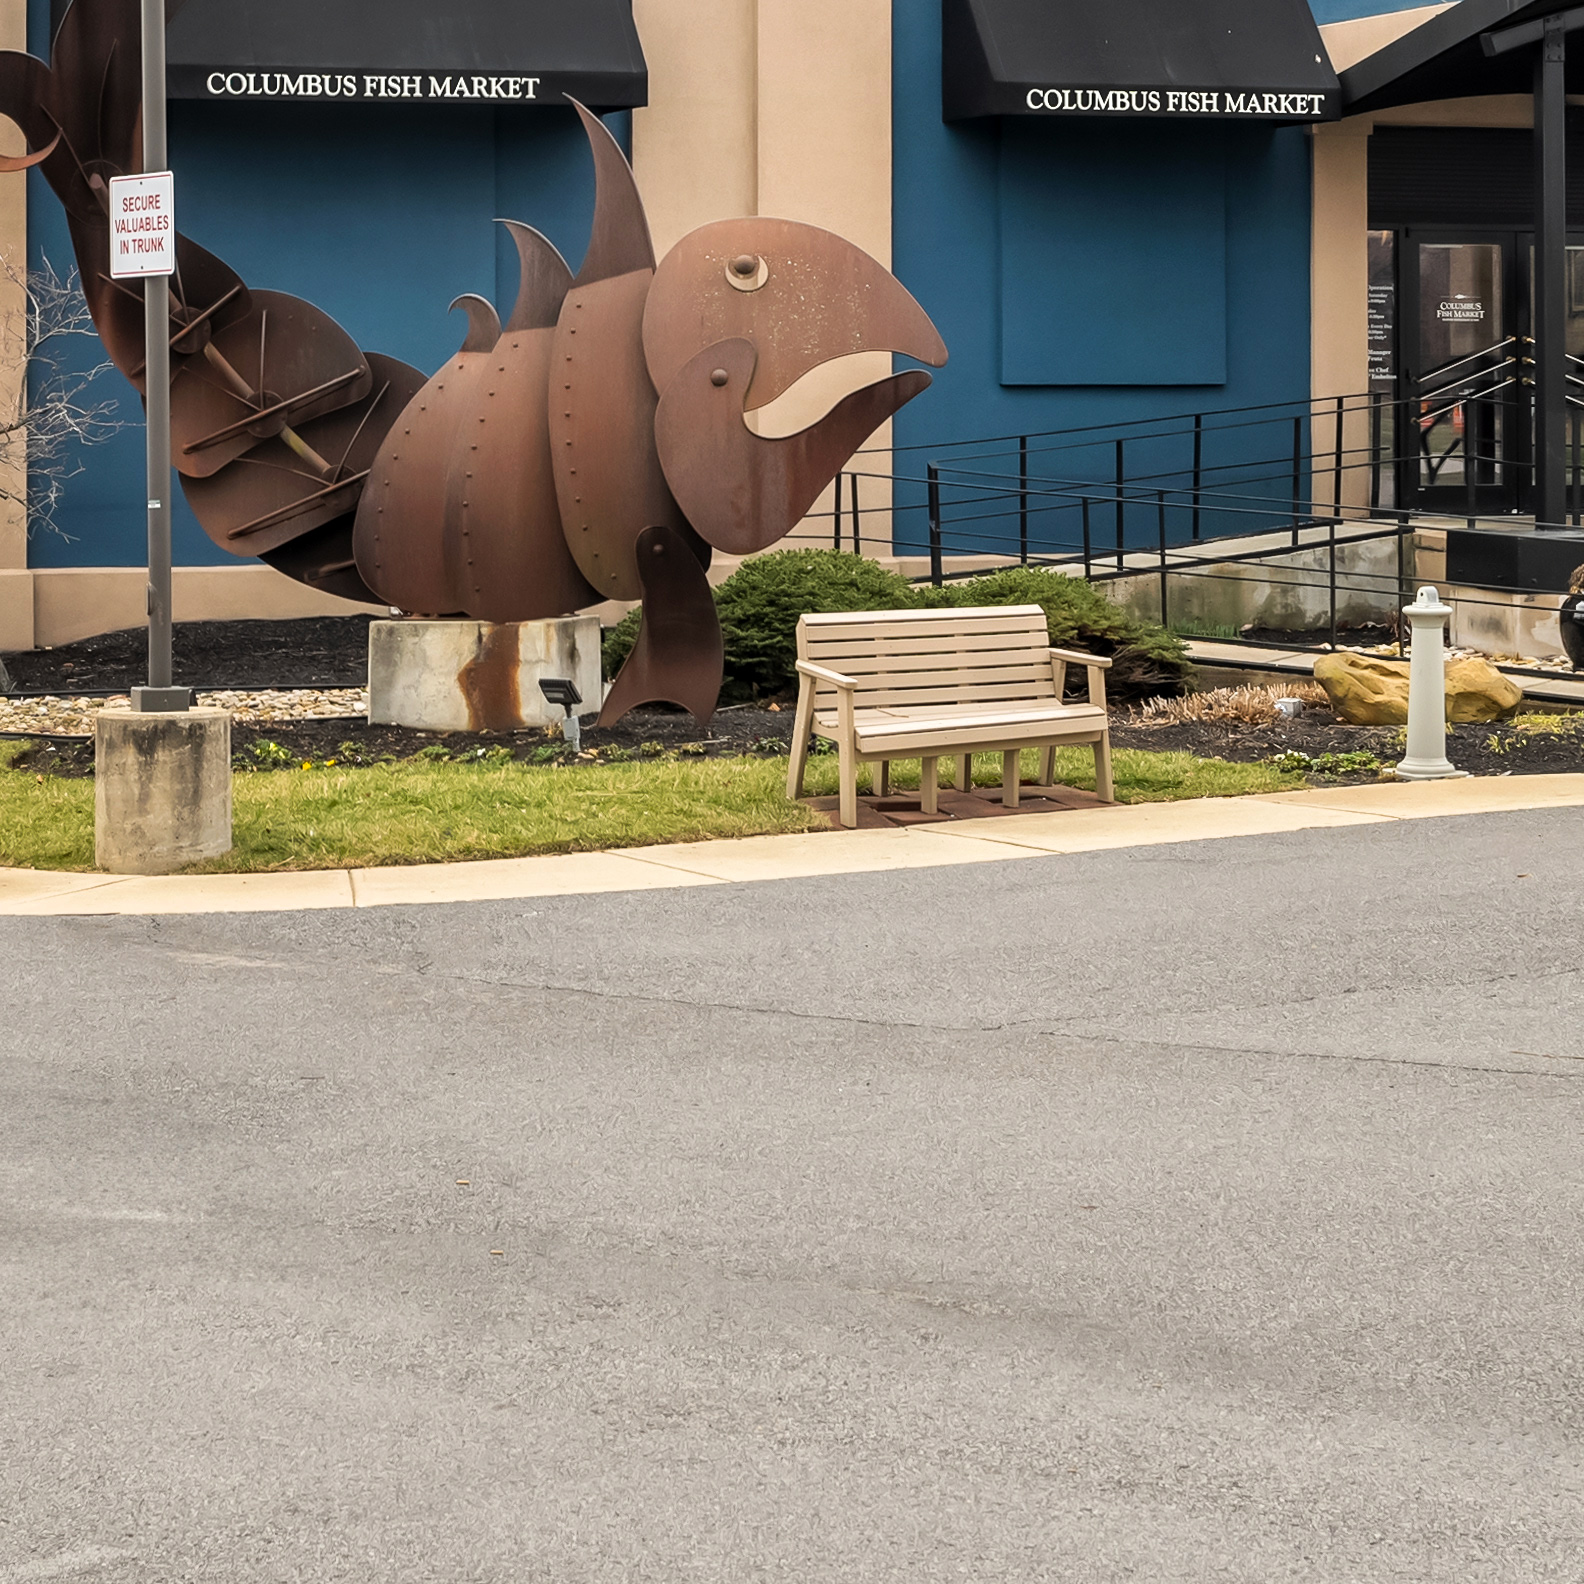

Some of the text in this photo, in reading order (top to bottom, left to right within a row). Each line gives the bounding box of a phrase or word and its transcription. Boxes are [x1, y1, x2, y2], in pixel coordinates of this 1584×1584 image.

[207, 72, 540, 99] COLUMBUS FISH MARKET
[1026, 88, 1325, 114] COLUMBUS FISH MARKET
[123, 194, 161, 212] SECURE
[115, 215, 169, 233] VALUABLES
[120, 237, 164, 254] IN TRUNK
[1437, 310, 1485, 319] FISH MARKET
